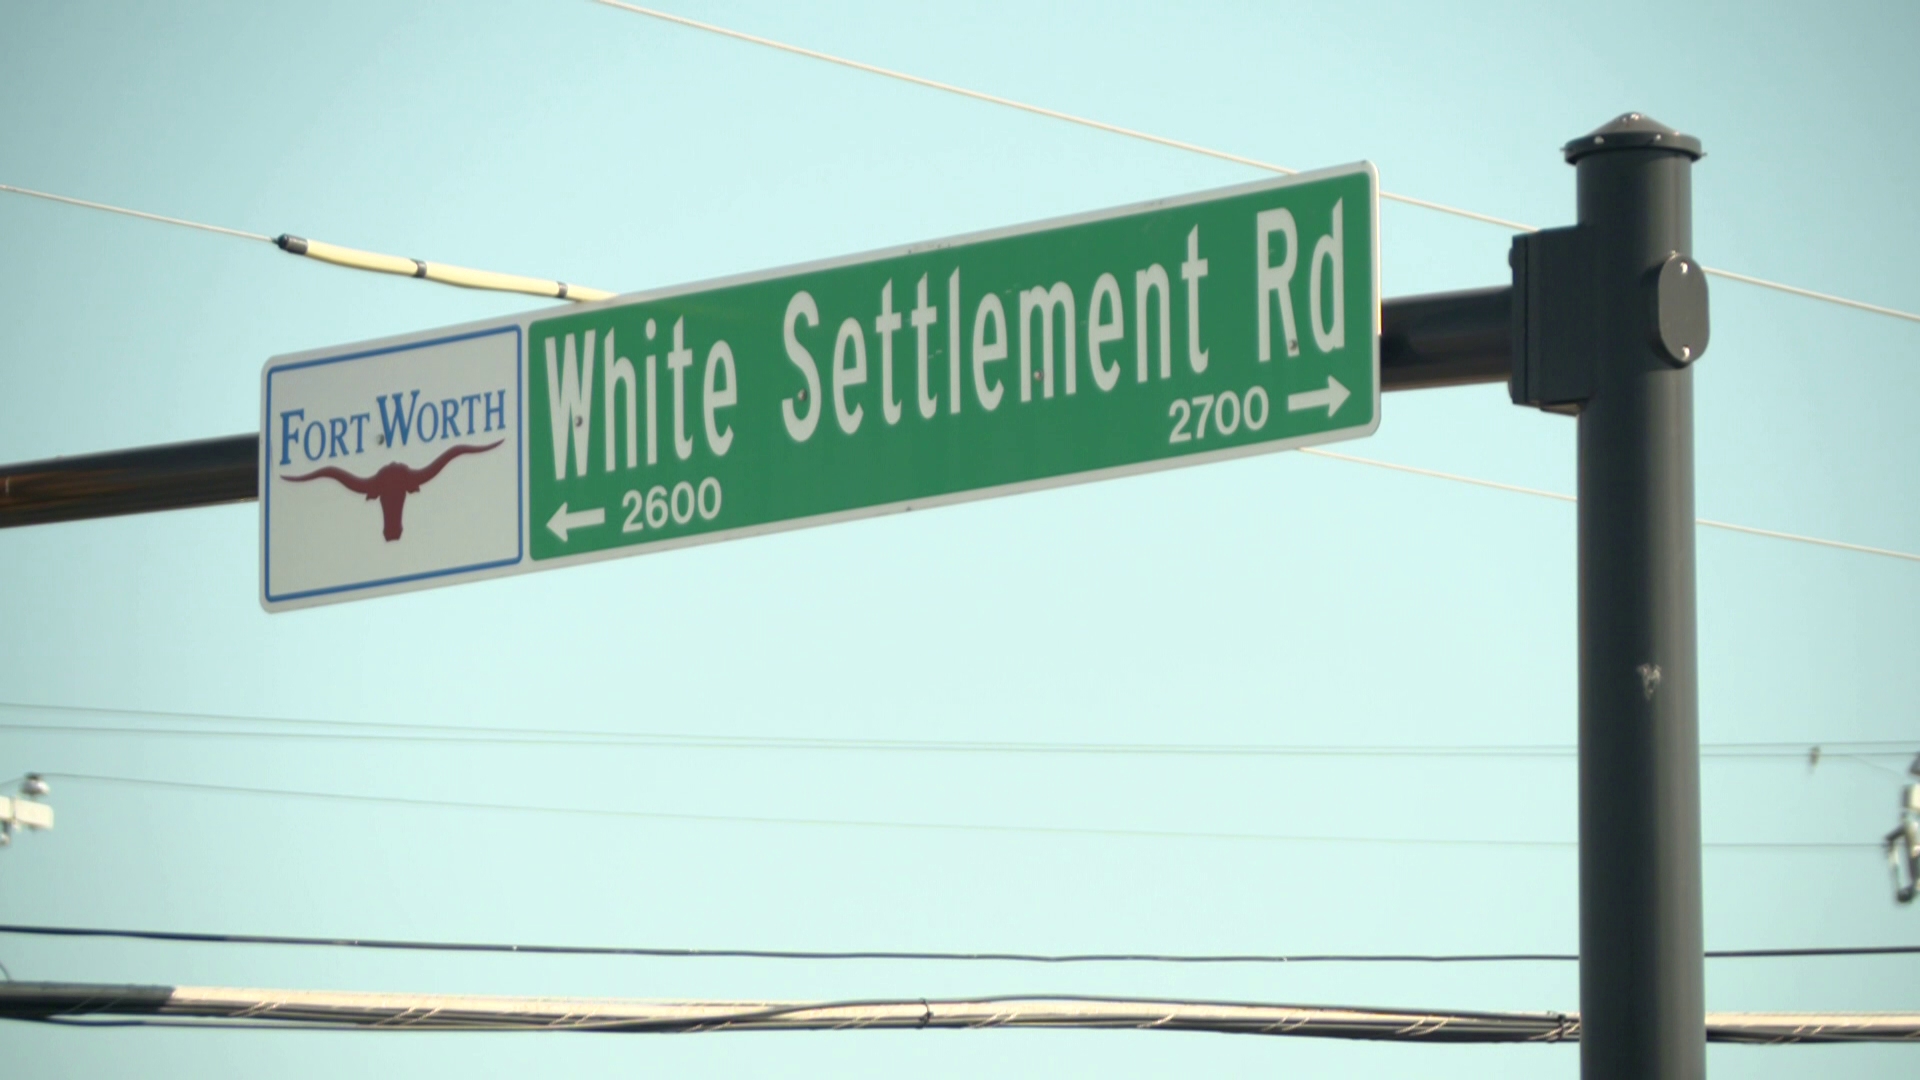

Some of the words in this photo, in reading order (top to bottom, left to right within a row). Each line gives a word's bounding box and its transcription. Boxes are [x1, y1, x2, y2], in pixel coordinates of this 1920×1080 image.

[544, 315, 738, 481] White
[781, 223, 1209, 442] Settlement
[1256, 197, 1345, 363] Rd
[278, 408, 370, 466] FORT
[375, 389, 507, 449] WORTH
[1168, 386, 1269, 444] 2700
[621, 476, 723, 534] 2600
